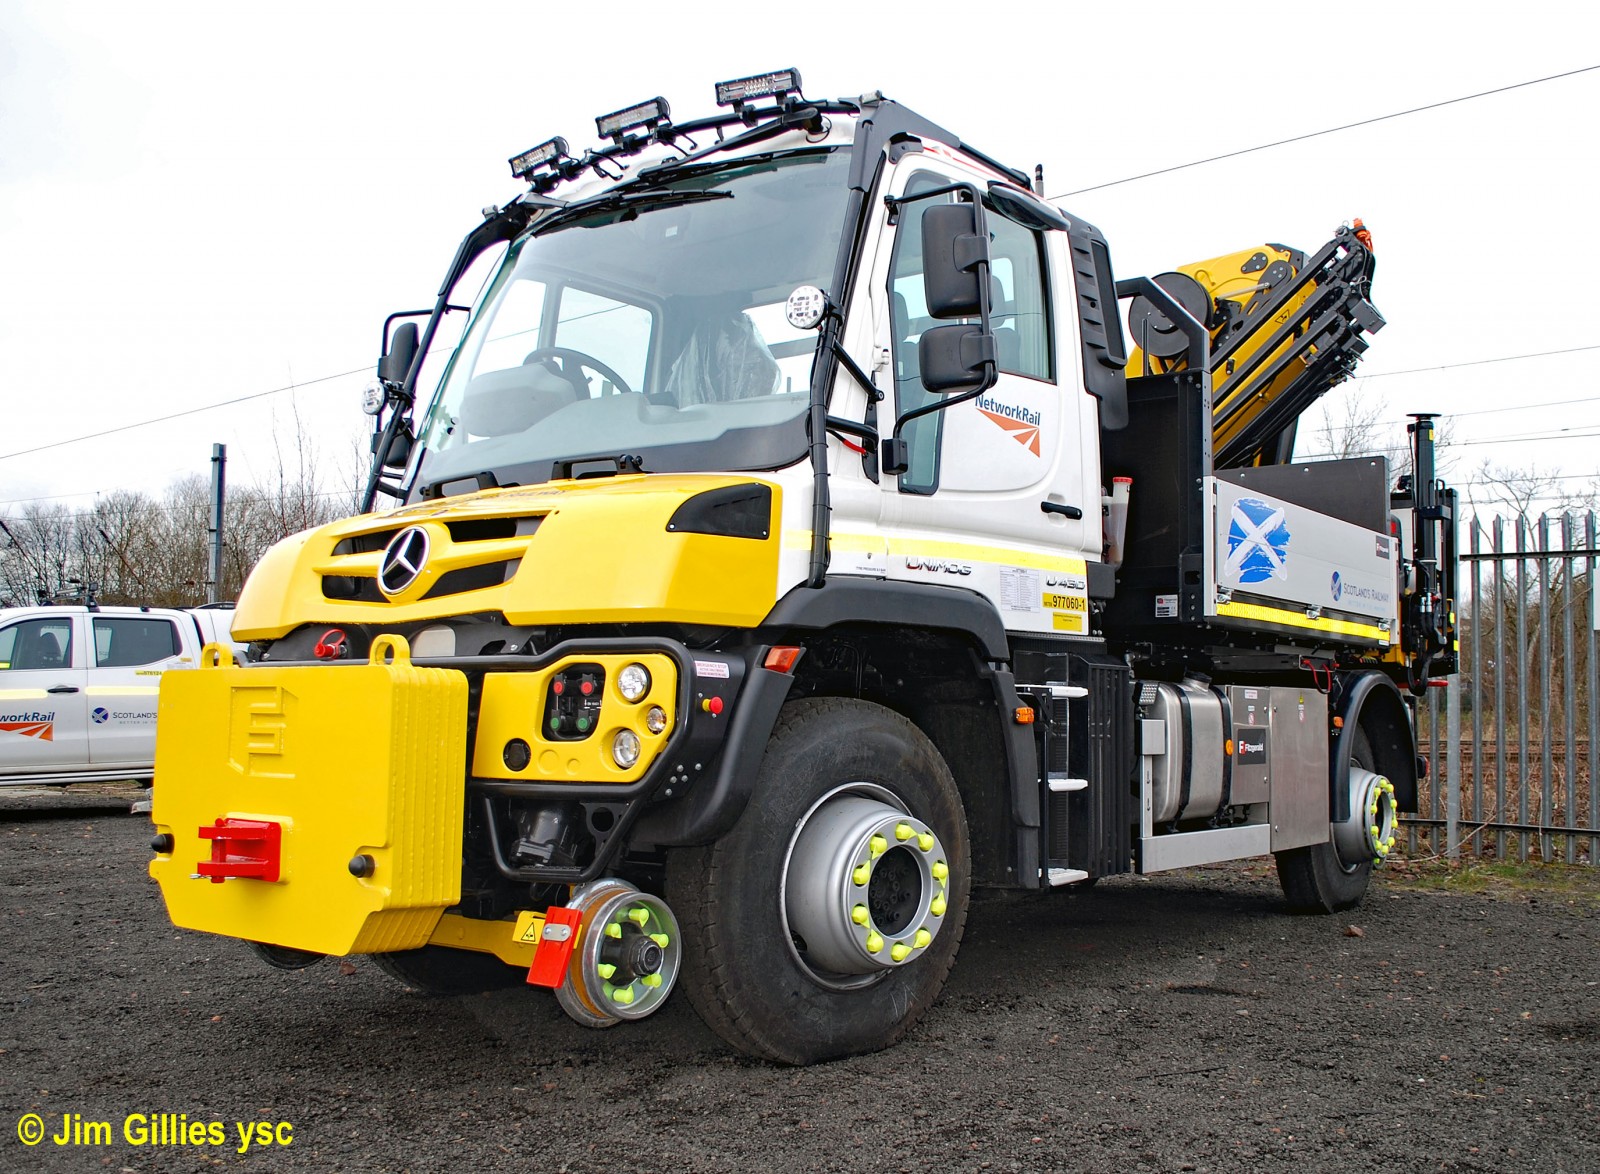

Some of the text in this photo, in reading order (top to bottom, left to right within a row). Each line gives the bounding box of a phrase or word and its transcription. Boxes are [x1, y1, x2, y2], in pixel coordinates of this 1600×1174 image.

[975, 394, 1041, 426] NetworkRail
[905, 556, 972, 576] UNIMOG
[1046, 575, 1058, 587] U
[1052, 595, 1085, 611] 977060-1
[112, 711, 158, 719] SCOTLAND'S
